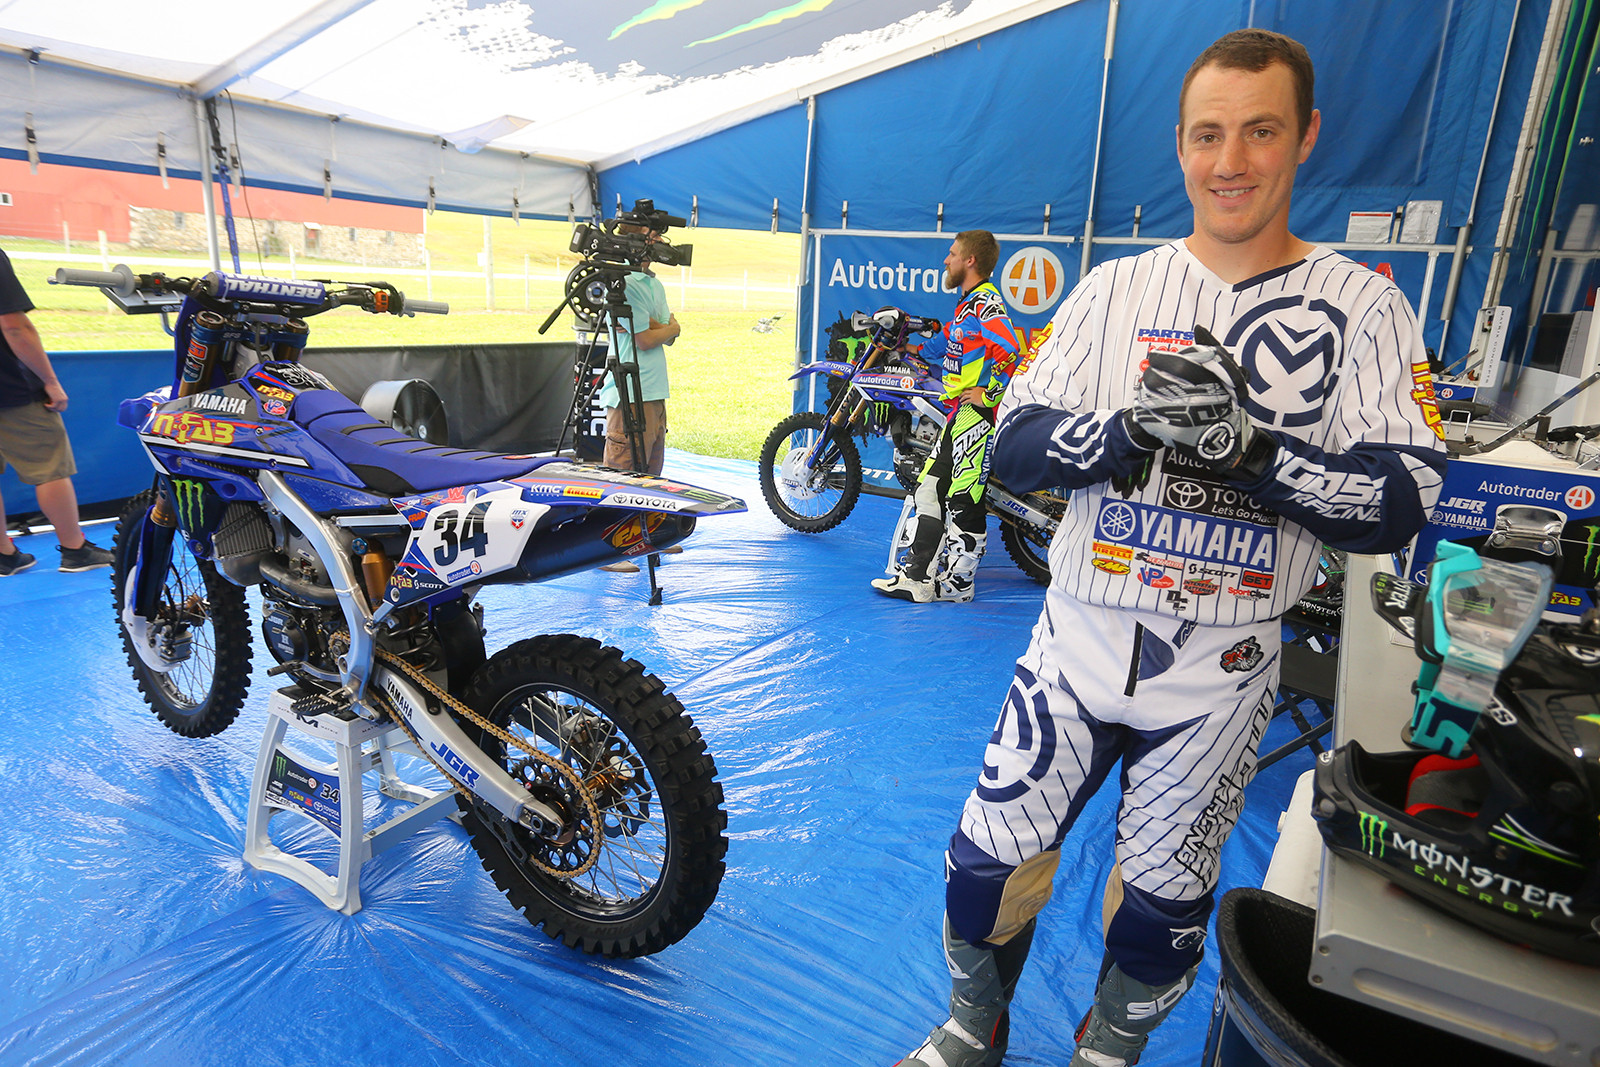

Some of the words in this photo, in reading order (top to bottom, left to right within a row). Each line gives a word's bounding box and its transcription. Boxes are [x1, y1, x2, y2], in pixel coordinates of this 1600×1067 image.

[226, 279, 323, 299] RENTHAL
[1137, 336, 1193, 346] UNLIMITED
[1138, 328, 1195, 341] PARTS
[830, 363, 852, 374] TOYOTA
[883, 365, 911, 374] YAMAHA
[858, 376, 899, 386] Autotrader
[193, 393, 247, 415] YAMAHA
[566, 487, 600, 497] PIRELLI
[1477, 480, 1562, 501] Autotrader
[629, 496, 677, 510] TOYOTA
[1002, 499, 1029, 517] JGR
[1211, 488, 1274, 512] TOYO
[1439, 497, 1487, 512] JGR
[1211, 504, 1234, 517] Let's
[1236, 508, 1250, 520] Go
[1442, 512, 1487, 528] YAMAHA
[433, 500, 493, 567] 34
[1139, 508, 1274, 569] YAMAHA
[1095, 545, 1133, 560] PIRELLI
[1139, 567, 1165, 587] VP
[1198, 568, 1238, 578] SCOTT
[1244, 574, 1271, 586] GET
[1299, 599, 1337, 617] MONSTER
[386, 677, 414, 721] YAMAHA
[430, 741, 480, 787] JGR
[320, 782, 340, 804] 34
[323, 805, 340, 817] TOYOTA
[1392, 832, 1575, 917] MONSTER
[1413, 864, 1544, 919] ENERGY
